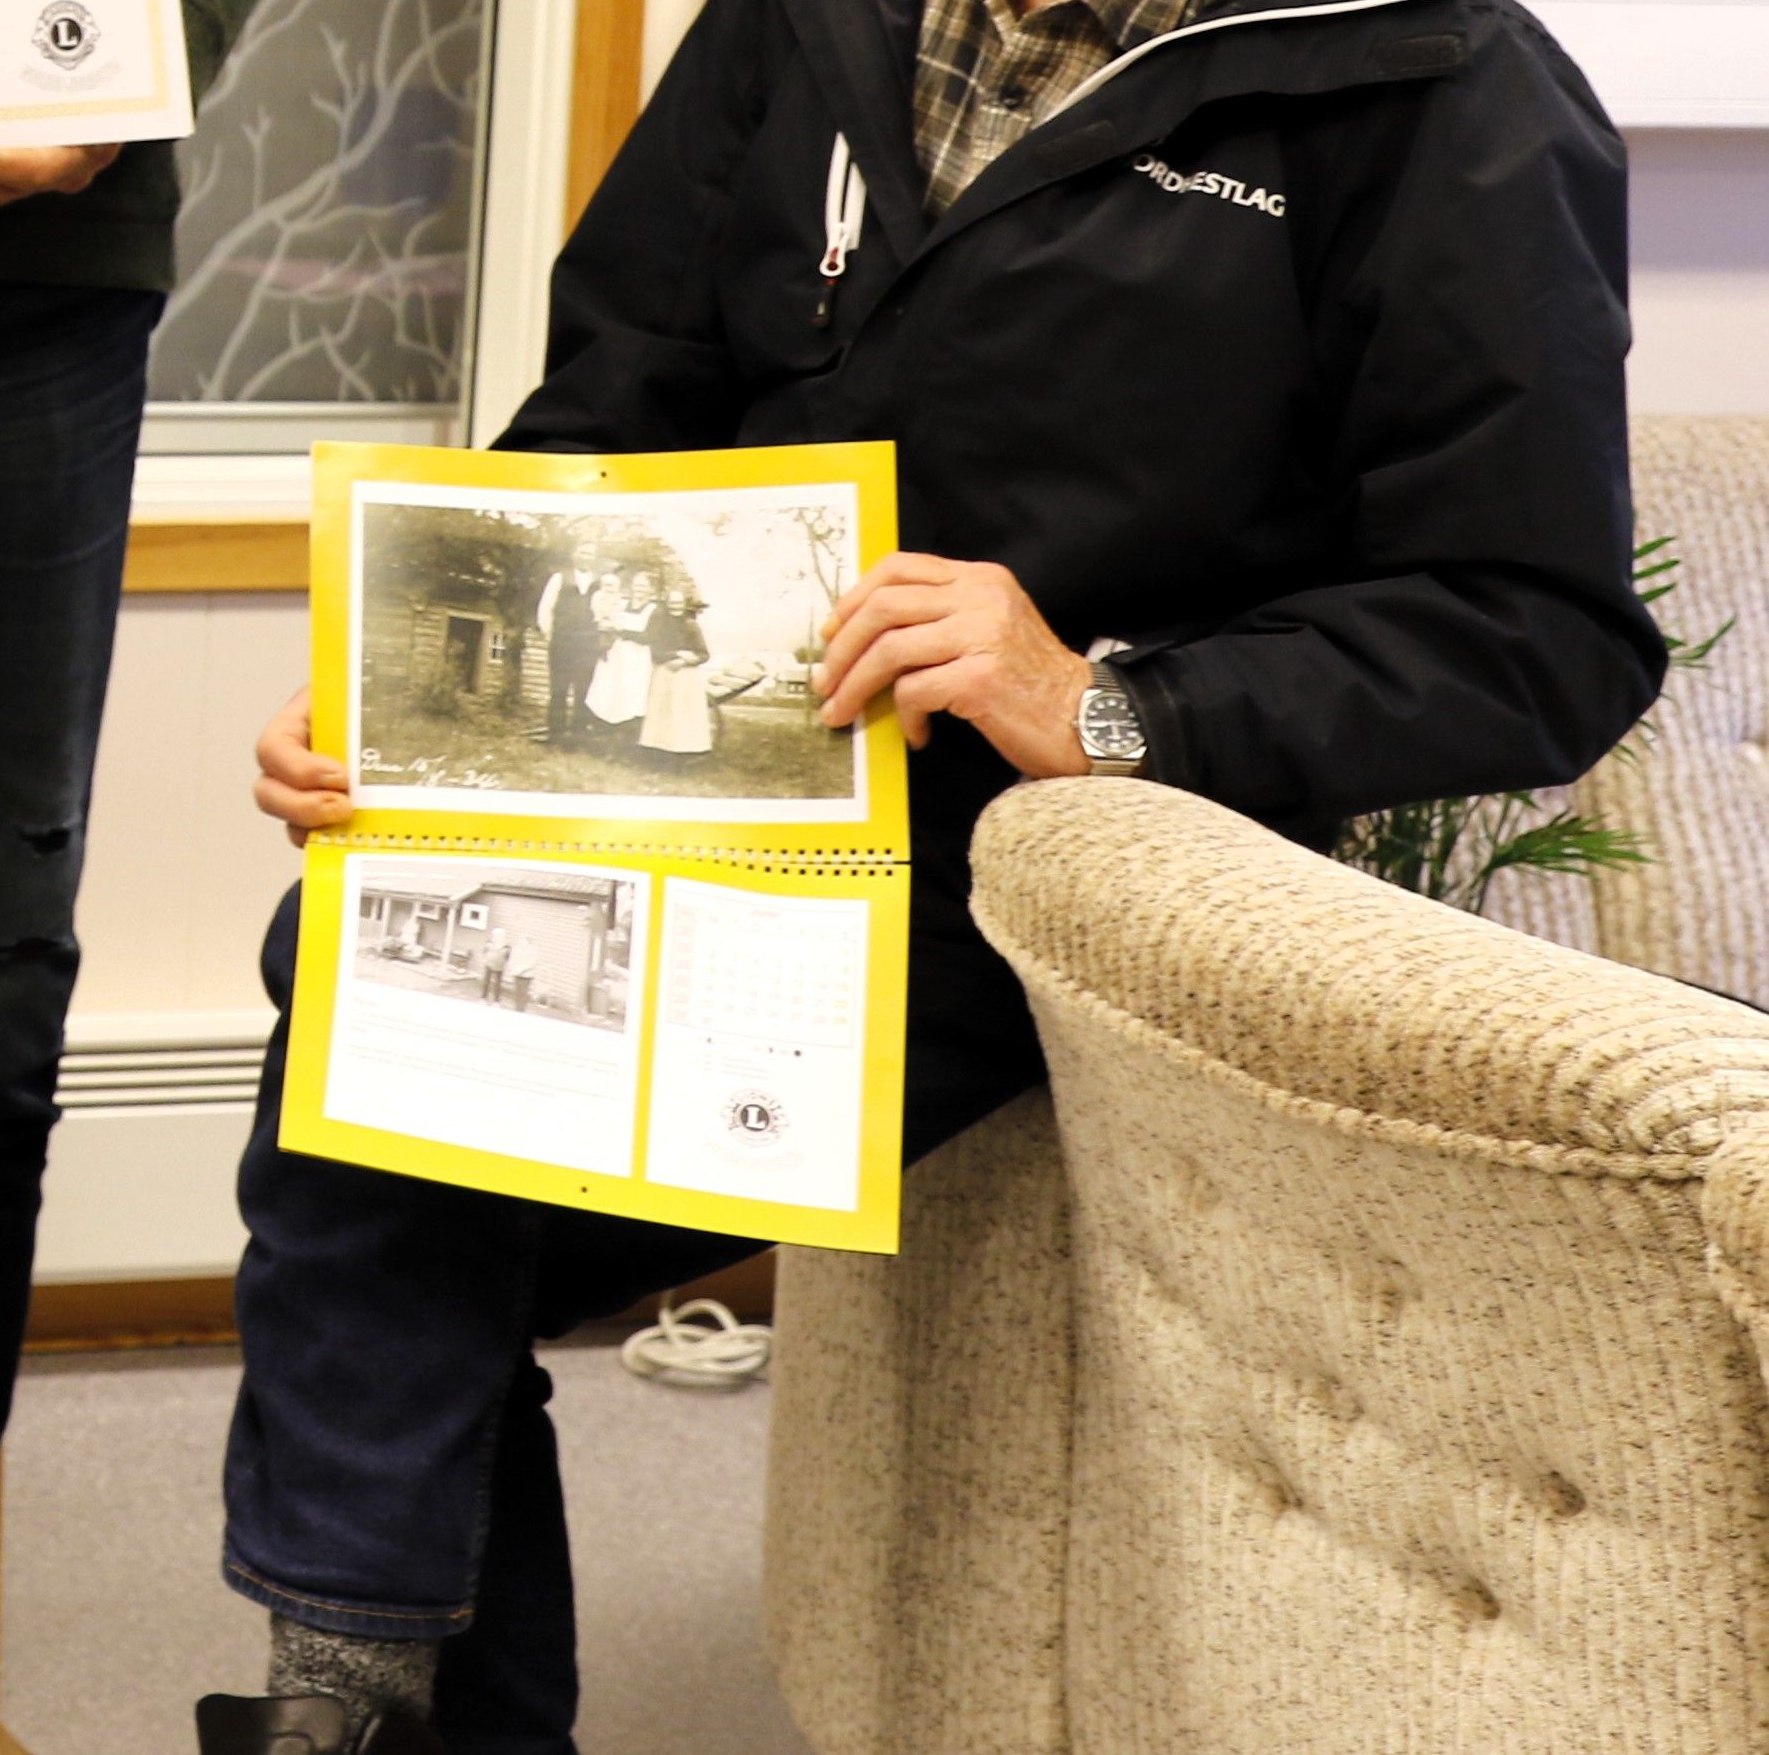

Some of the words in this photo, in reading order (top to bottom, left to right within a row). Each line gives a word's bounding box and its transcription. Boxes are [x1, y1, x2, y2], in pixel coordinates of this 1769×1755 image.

[56, 20, 79, 47] L
[1132, 153, 1287, 218] ORDESTLAG
[743, 1105, 767, 1130] L
